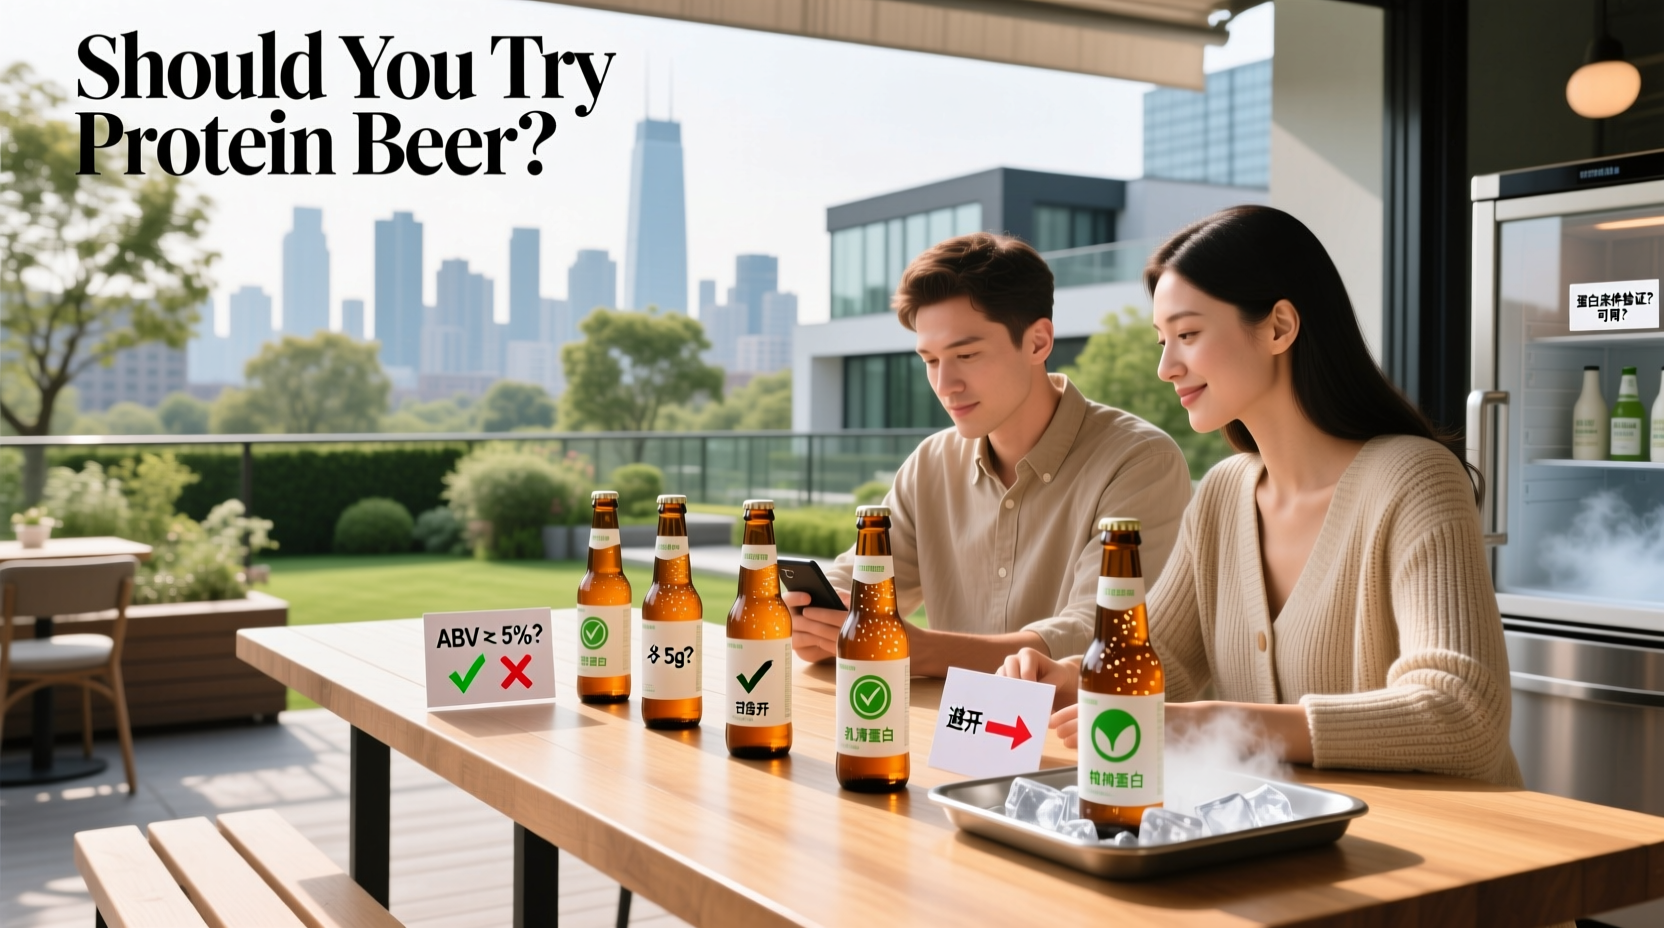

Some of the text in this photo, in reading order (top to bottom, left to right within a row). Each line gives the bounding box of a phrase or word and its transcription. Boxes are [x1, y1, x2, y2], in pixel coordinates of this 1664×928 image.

[436, 627, 480, 648] ABV
[502, 623, 543, 645] 5%?
[664, 645, 695, 669] 5g?
